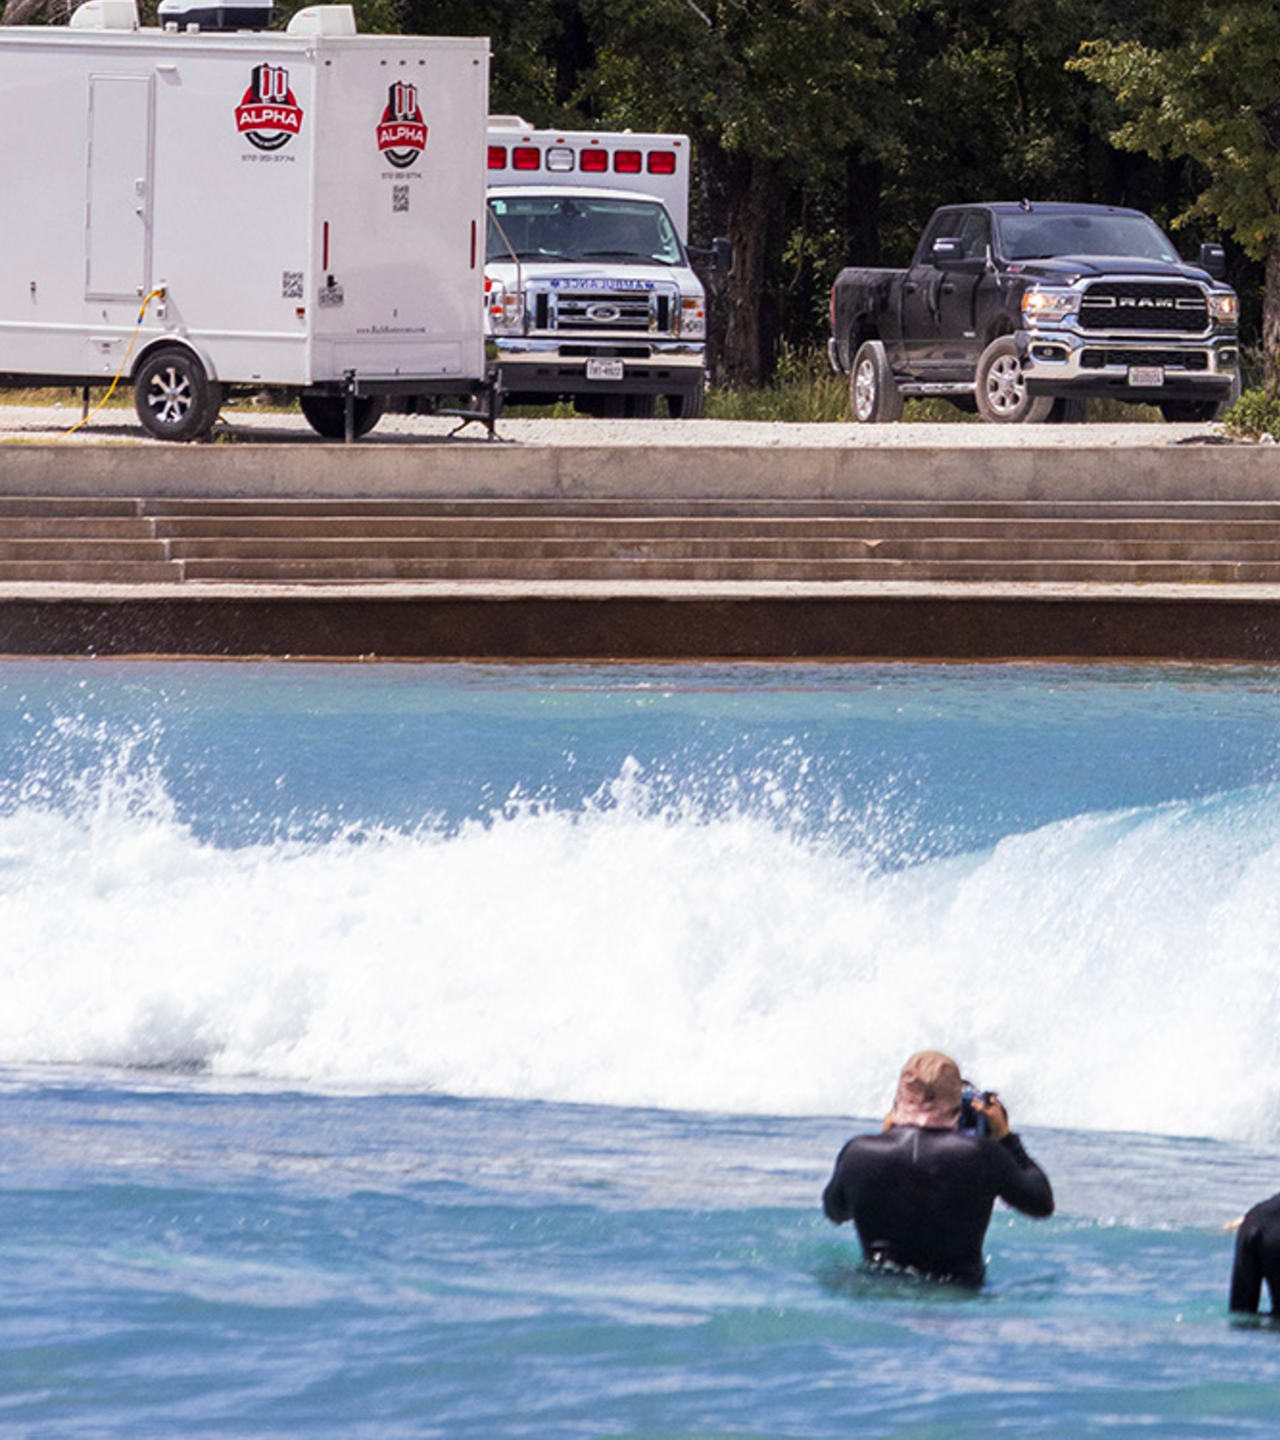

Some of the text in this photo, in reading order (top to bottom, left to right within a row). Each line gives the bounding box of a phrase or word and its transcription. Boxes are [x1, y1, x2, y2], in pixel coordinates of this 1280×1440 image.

[239, 109, 299, 127] ALPHA
[380, 127, 424, 143] ALPHA
[1119, 297, 1173, 308] RAM
